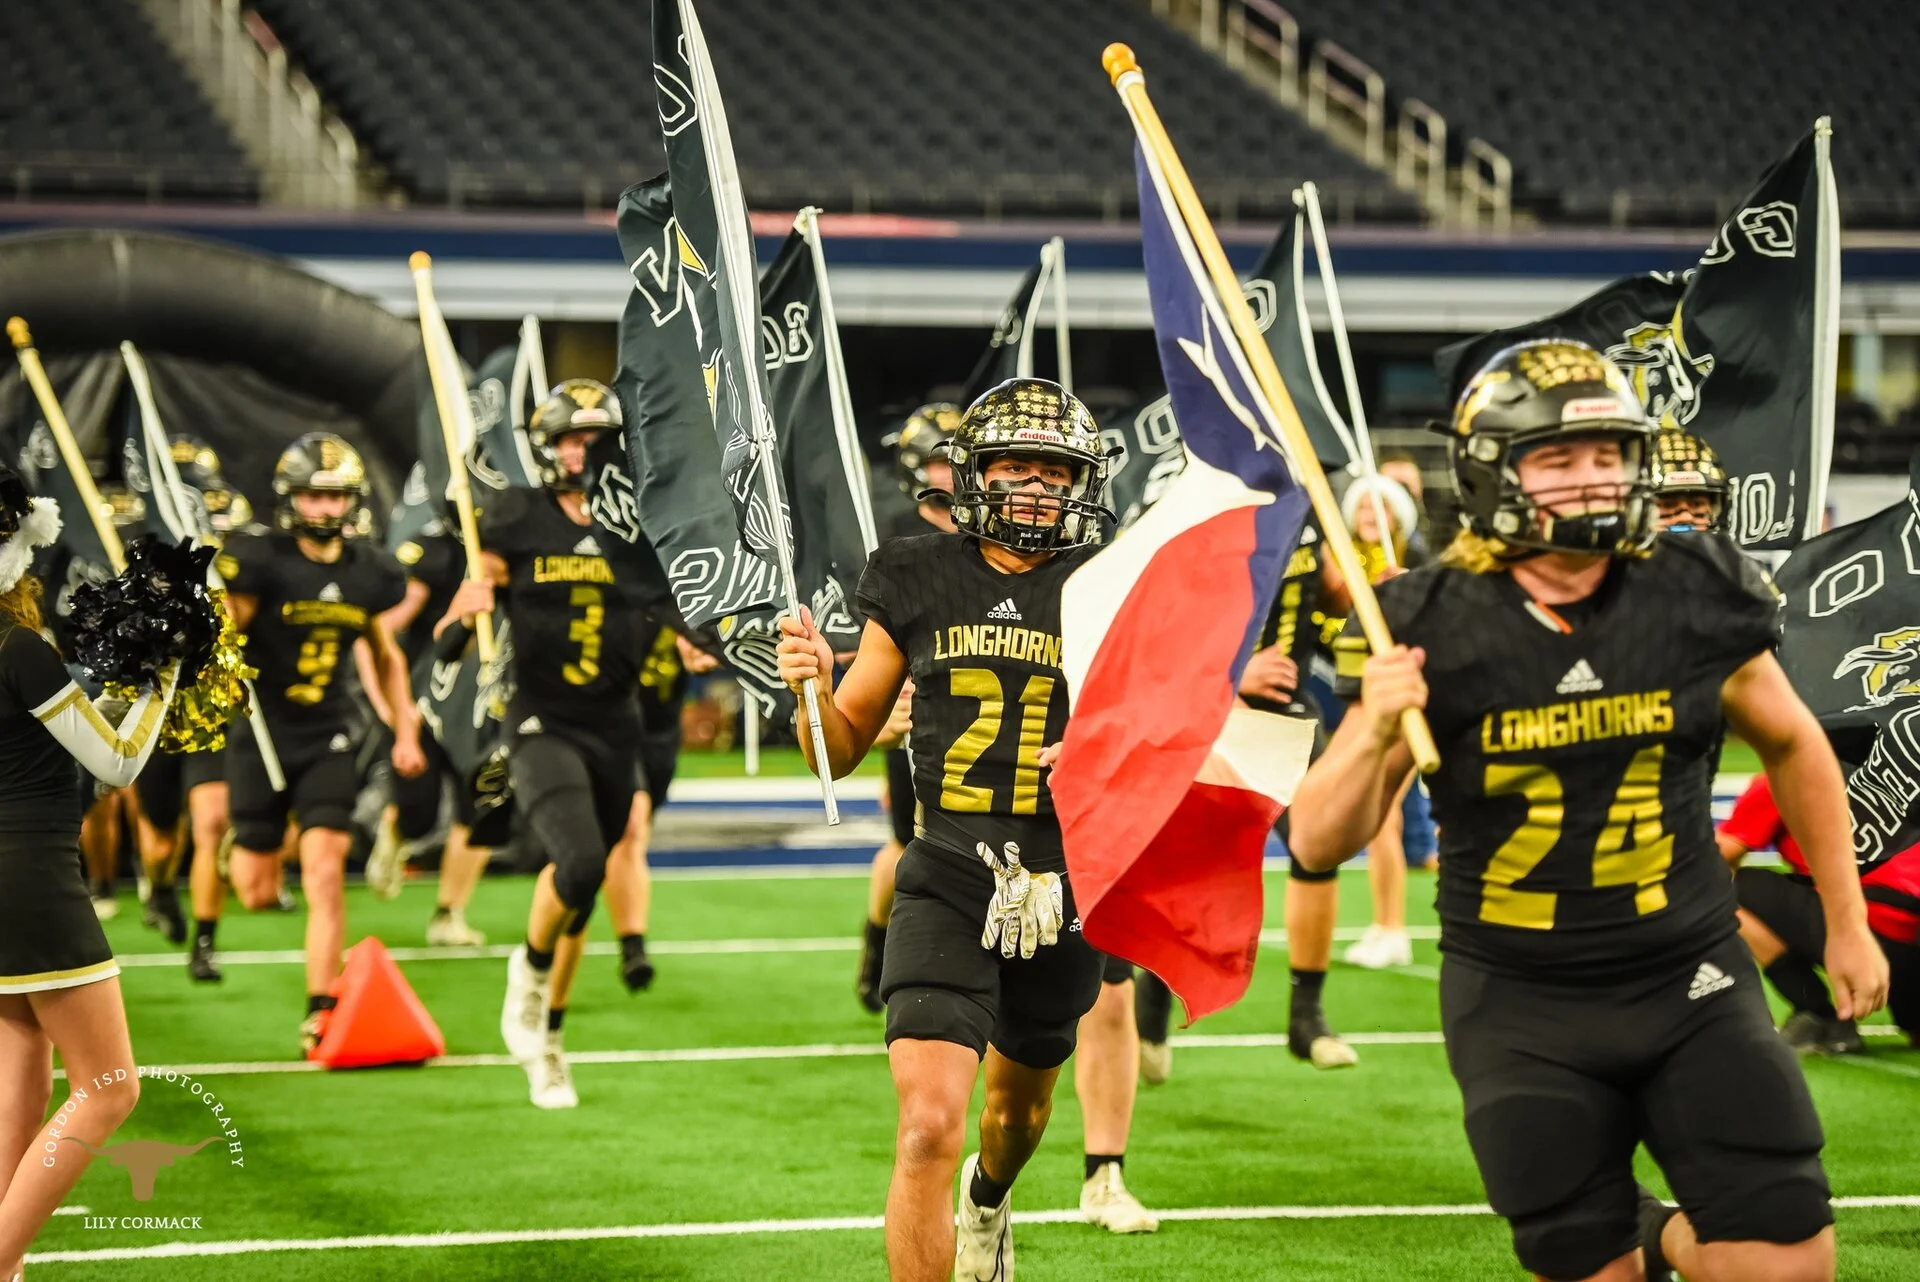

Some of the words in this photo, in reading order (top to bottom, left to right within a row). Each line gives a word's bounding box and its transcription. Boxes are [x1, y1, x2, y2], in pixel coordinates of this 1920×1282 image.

[562, 585, 605, 686] 3
[934, 624, 1063, 669] LONGHORN
[987, 610, 1022, 621] adidas
[939, 668, 1056, 815] 21
[1481, 689, 1674, 753] LONGHORNS
[1478, 743, 1676, 930] 24
